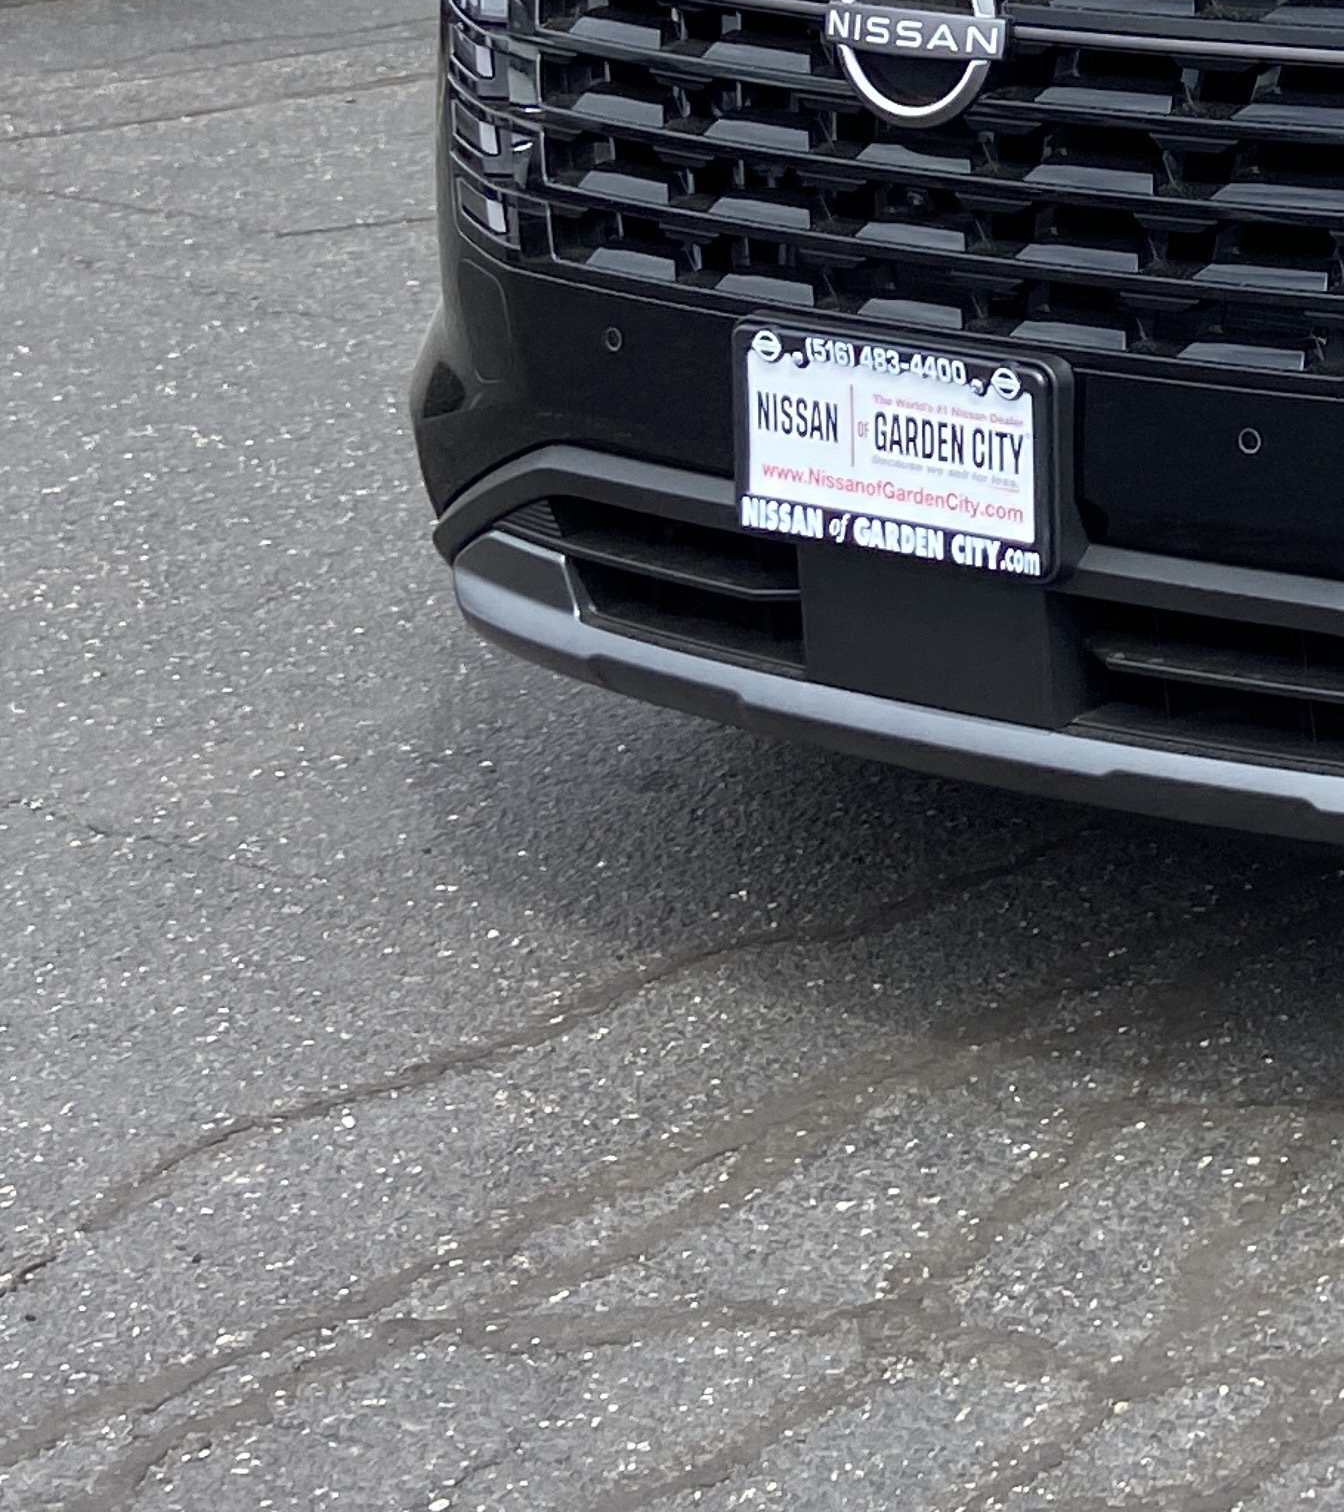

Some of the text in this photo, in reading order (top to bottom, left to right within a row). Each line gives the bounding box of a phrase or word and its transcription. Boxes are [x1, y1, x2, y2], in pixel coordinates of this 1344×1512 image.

[828, 8, 999, 55] NISSAN
[804, 336, 968, 385] (516) 483-4400
[756, 390, 839, 444] NISSAN
[857, 411, 1024, 476] OF GARDEN CITY
[761, 461, 1024, 524] www.NissanofGardenCity.com
[741, 496, 1042, 577] NISSAN of GARDEN CITY.com
